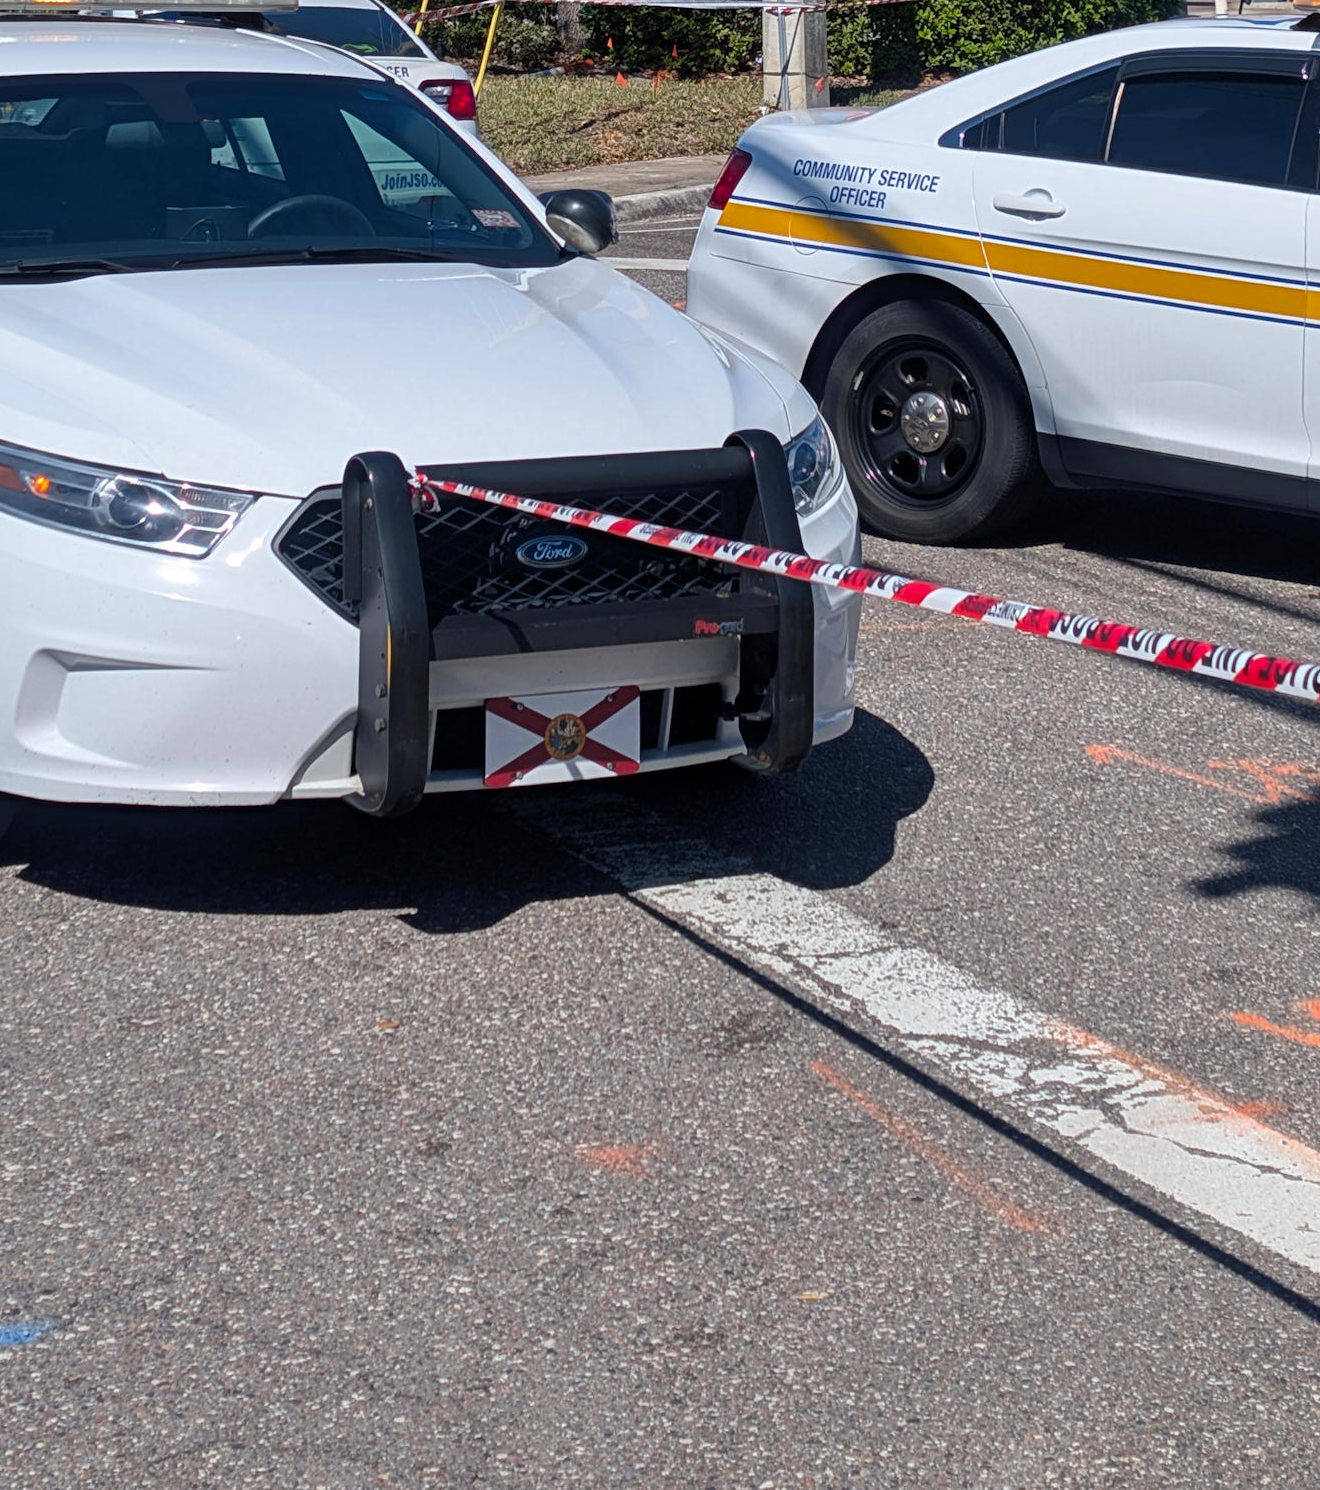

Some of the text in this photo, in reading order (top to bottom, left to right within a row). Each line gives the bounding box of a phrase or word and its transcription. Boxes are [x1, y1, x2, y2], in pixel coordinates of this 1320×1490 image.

[381, 172, 447, 191] JoinJSO.co
[793, 159, 940, 193] COMMUNITY SERVICE
[830, 185, 887, 209] OFFICER
[534, 541, 573, 560] Ford
